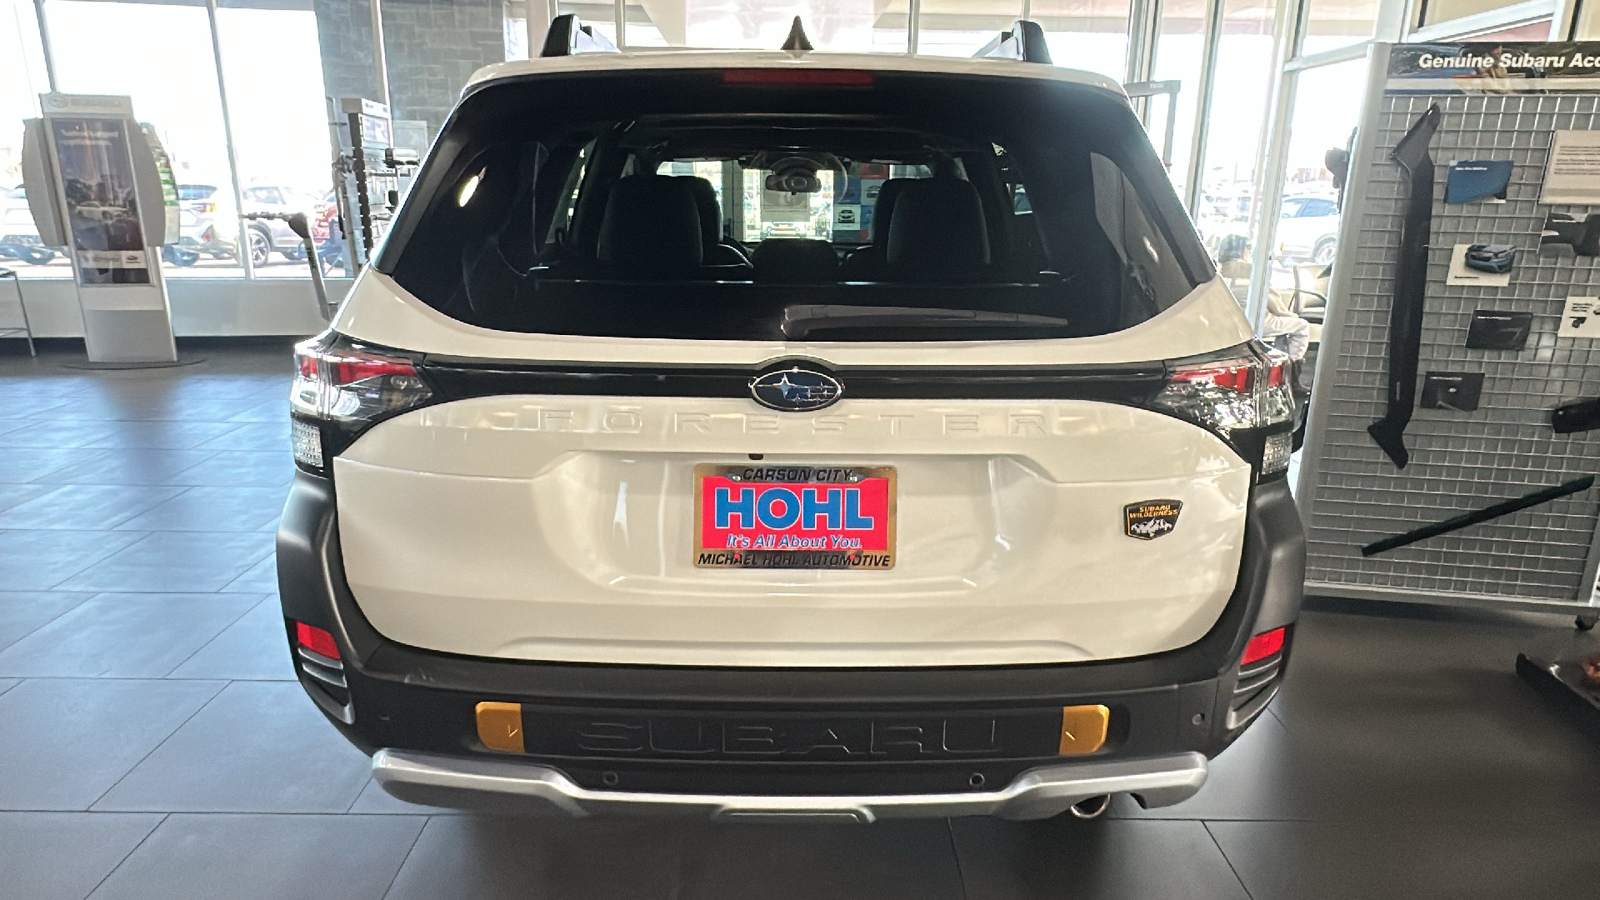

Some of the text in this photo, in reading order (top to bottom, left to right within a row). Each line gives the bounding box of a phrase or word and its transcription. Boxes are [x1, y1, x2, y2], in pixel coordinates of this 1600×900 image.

[1418, 53, 1494, 68] Genuine
[1499, 53, 1566, 68] Subaru
[537, 409, 1046, 435] FORESTER
[742, 468, 853, 481] CARSON CITY
[715, 487, 874, 530] HOHL
[1129, 508, 1178, 519] WILDERNESS
[1139, 504, 1171, 513] SUBARU
[727, 534, 863, 549] It's All About You.
[698, 552, 891, 567] MICHAEL HOHL AUTOMOTIVE
[579, 719, 1001, 755] SUBARU
